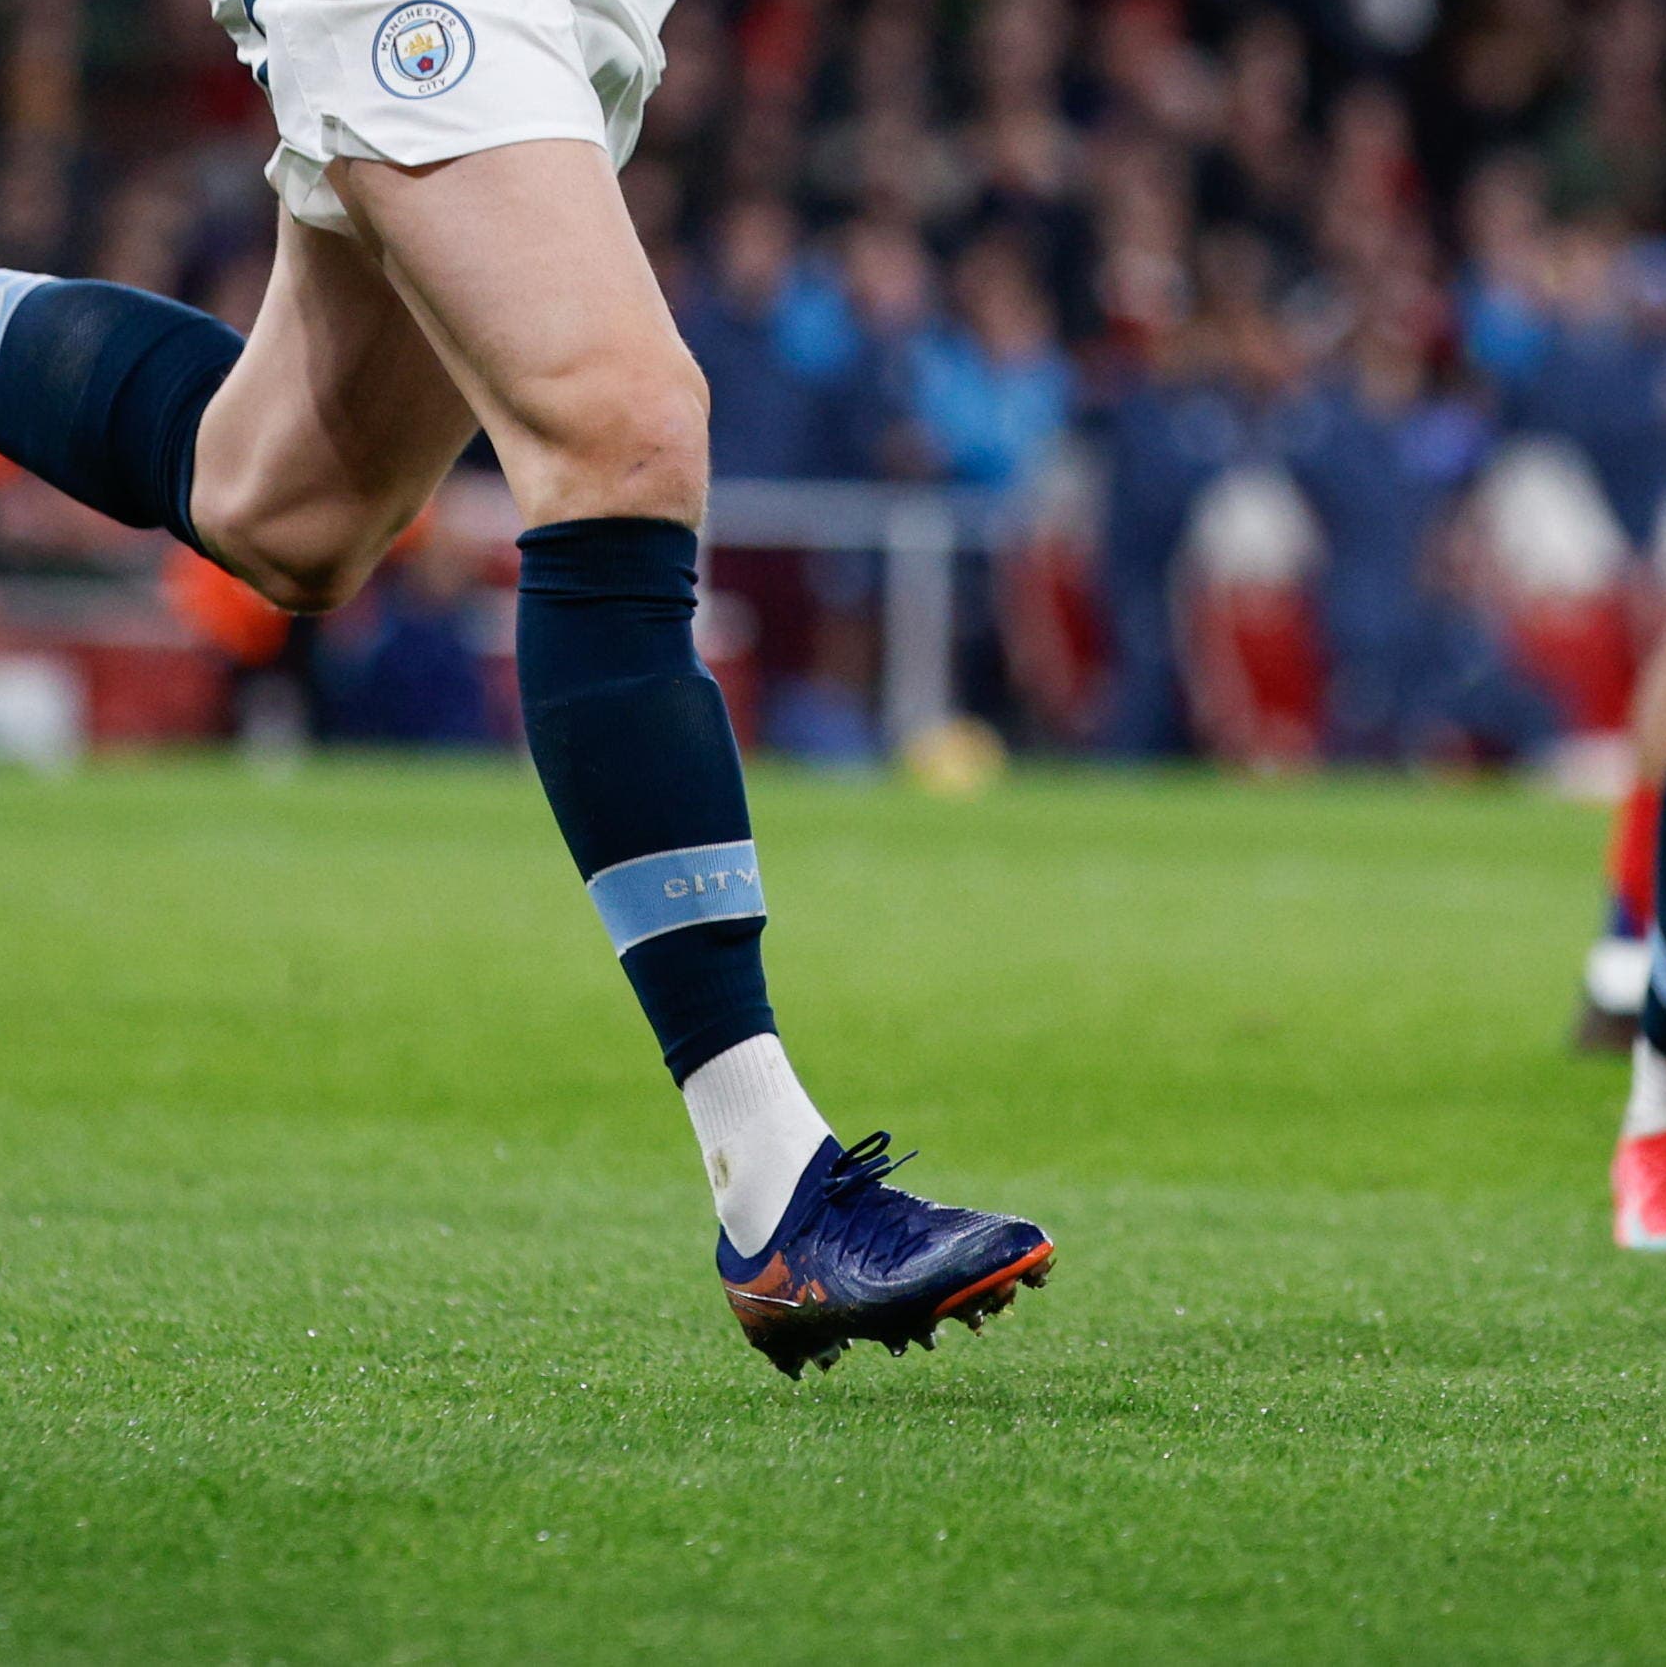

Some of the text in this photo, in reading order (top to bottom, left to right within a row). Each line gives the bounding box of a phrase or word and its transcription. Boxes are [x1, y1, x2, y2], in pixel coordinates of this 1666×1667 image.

[381, 6, 457, 52] MANCHESTER
[417, 77, 447, 94] CITY
[663, 867, 760, 900] CITY
